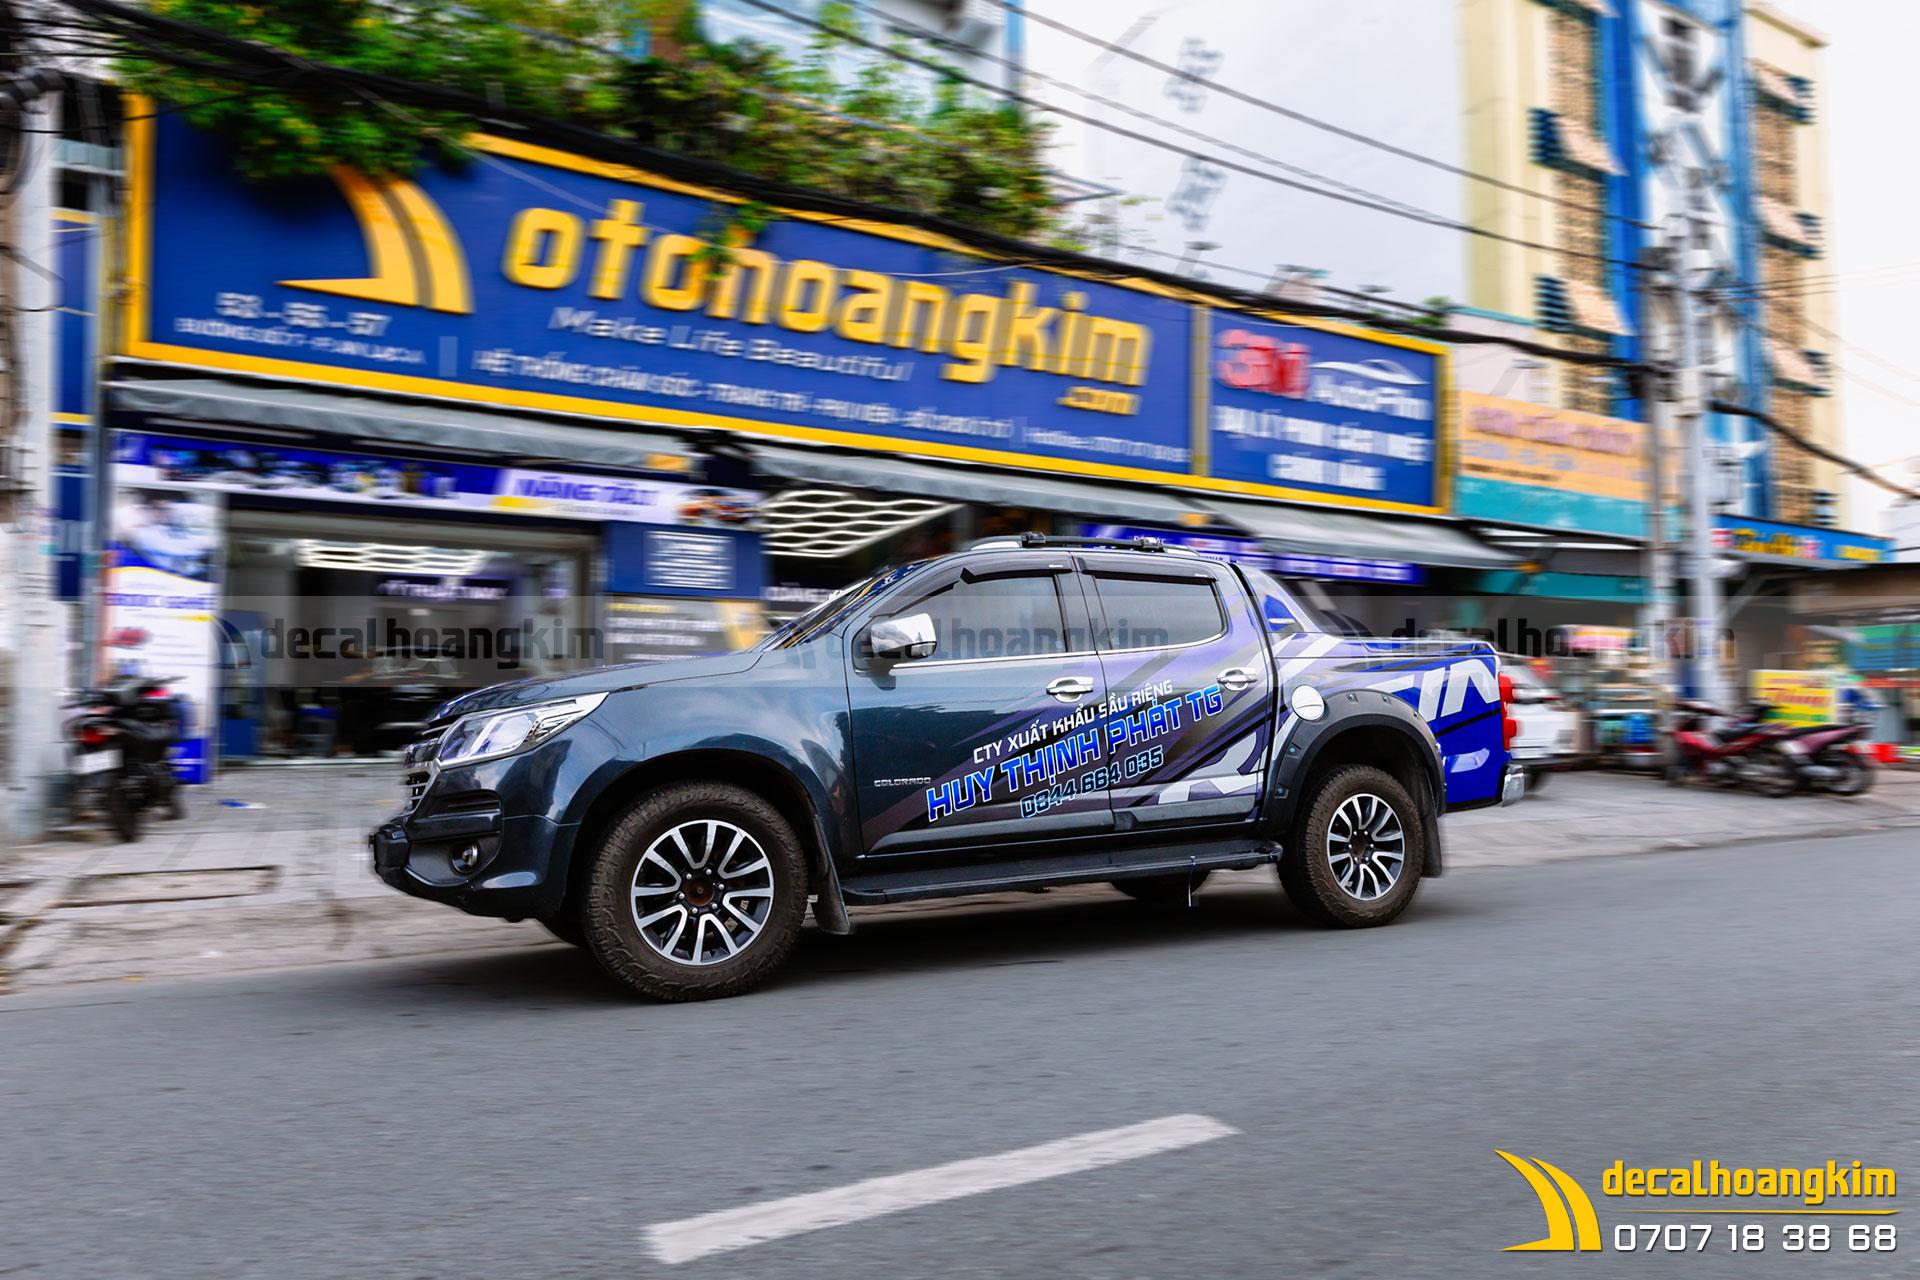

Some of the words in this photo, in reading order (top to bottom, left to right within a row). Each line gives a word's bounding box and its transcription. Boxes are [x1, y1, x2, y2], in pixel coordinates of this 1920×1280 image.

[549, 306, 667, 345] Make
[668, 324, 745, 357] Life
[746, 337, 914, 382] Beautiful
[926, 766, 995, 822] HUY
[1000, 734, 1101, 794] THỊNH
[1107, 696, 1183, 755] PHÁT
[1185, 683, 1224, 723] TG
[973, 740, 1002, 764] CTY
[1007, 718, 1049, 752] XUẤT
[1052, 702, 1095, 736] KHẨU
[1098, 691, 1129, 719] SẦU
[1131, 679, 1173, 707] RIÊNG
[873, 776, 931, 788] COLORADO
[1080, 764, 1121, 796] 664
[1124, 745, 1164, 779] 035
